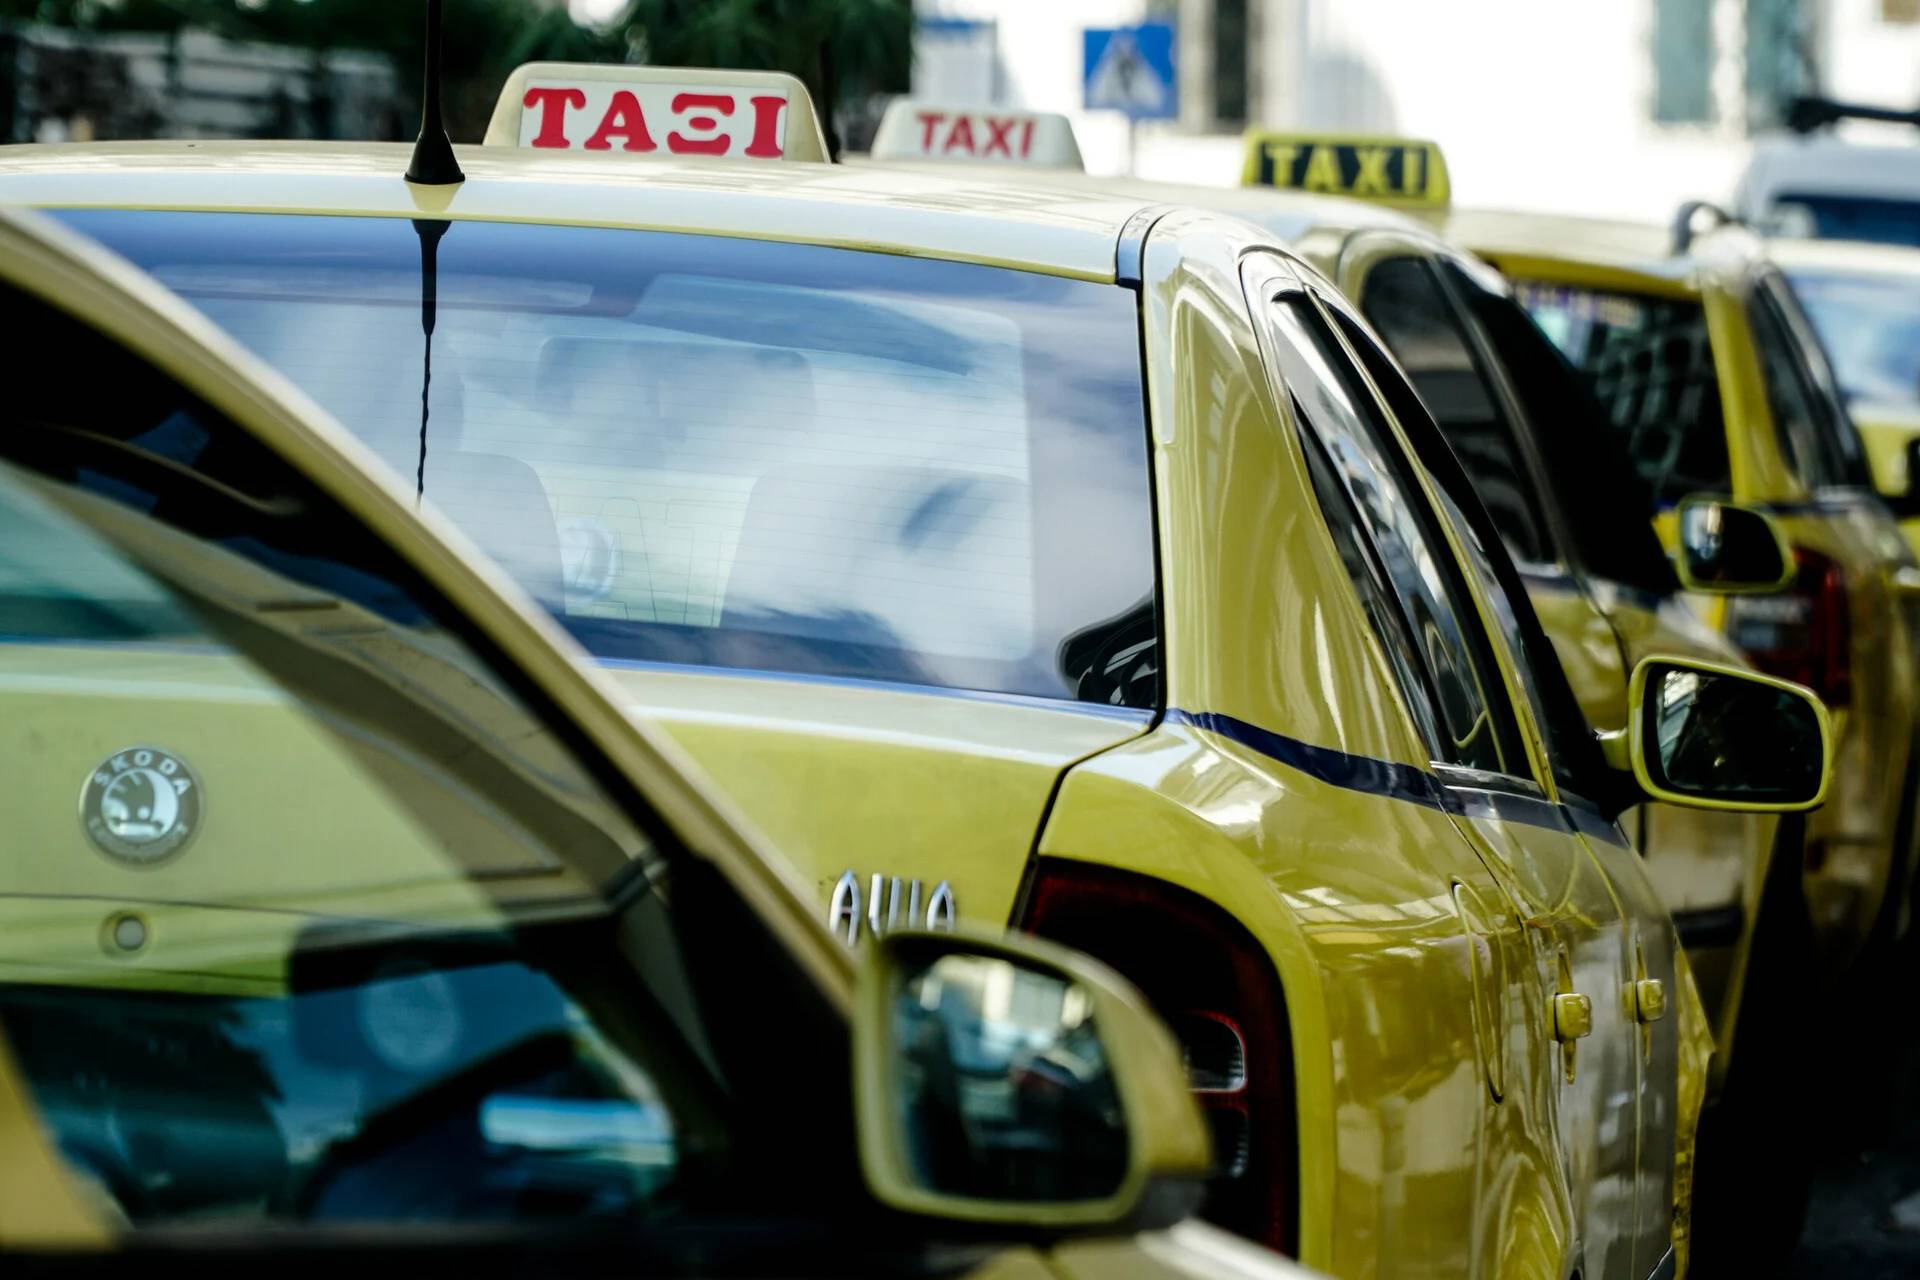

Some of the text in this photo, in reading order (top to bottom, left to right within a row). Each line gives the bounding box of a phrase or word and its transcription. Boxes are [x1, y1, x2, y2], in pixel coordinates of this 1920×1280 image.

[522, 86, 788, 158] ΤΑΞΙ
[916, 110, 1036, 159] TAXI
[1265, 144, 1422, 197] TAXI
